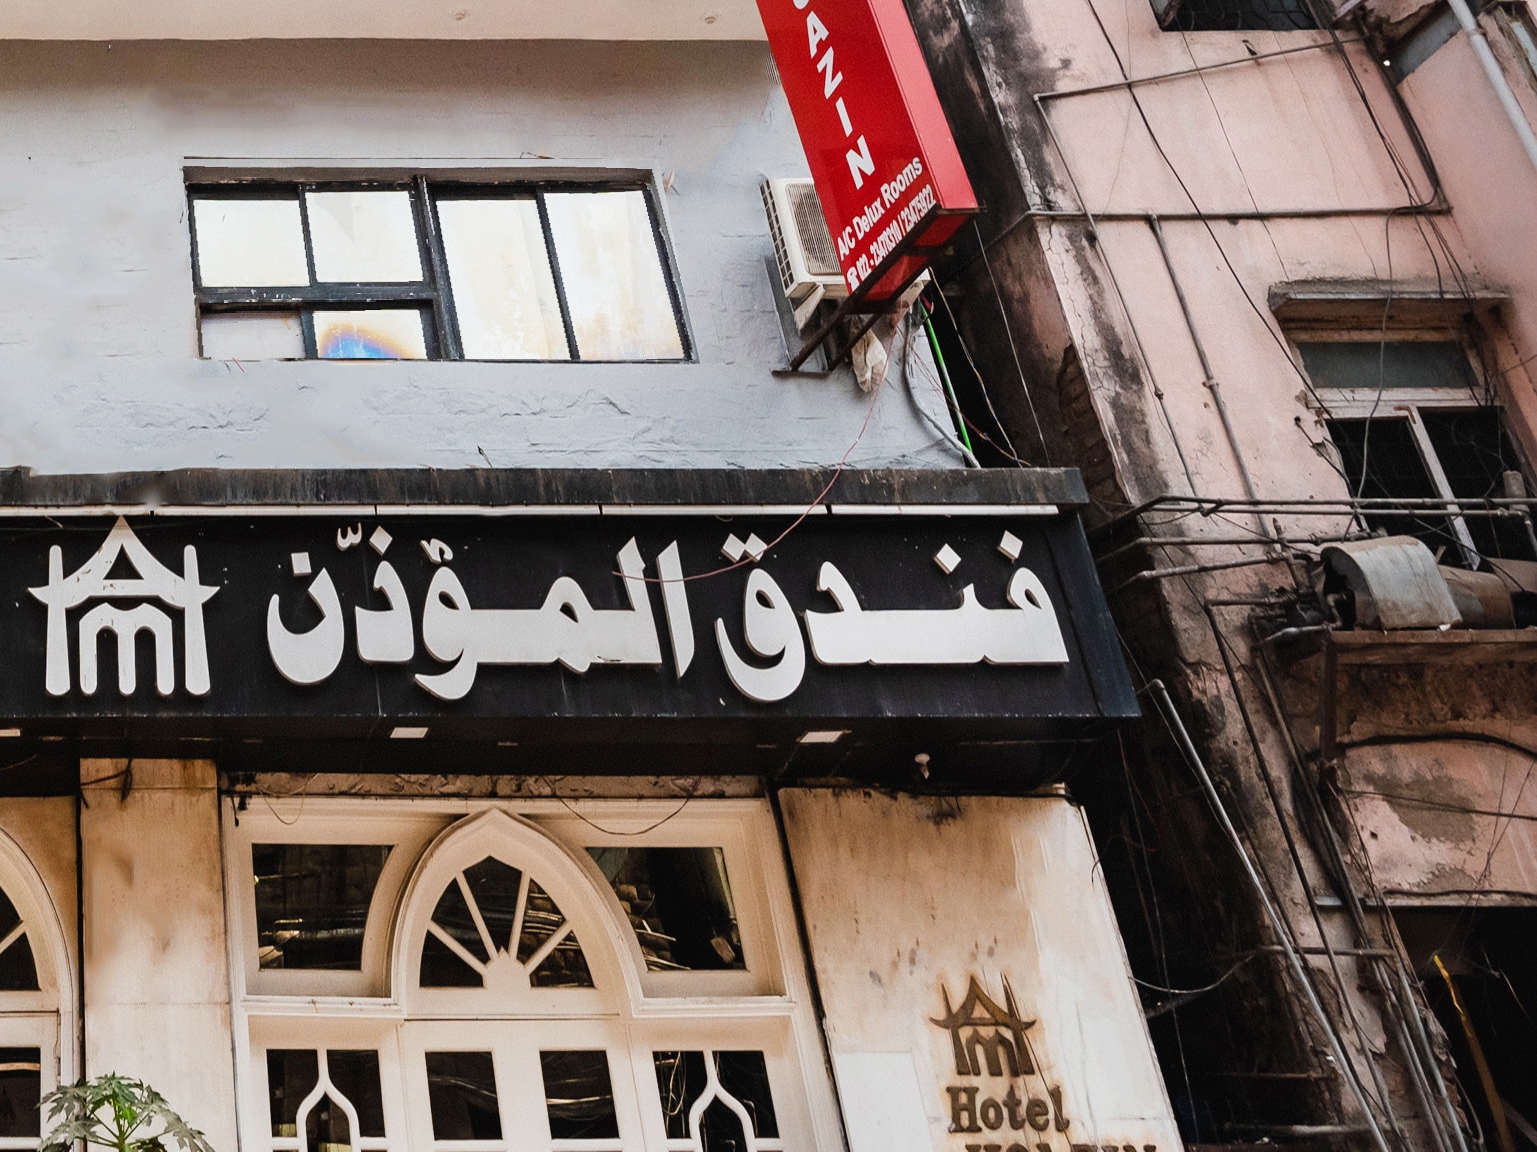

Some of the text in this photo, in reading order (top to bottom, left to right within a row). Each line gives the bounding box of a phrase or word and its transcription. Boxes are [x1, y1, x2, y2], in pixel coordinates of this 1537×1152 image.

[837, 157, 923, 262] A/C Delux Rooms
[945, 1082, 1071, 1134] Hotel
